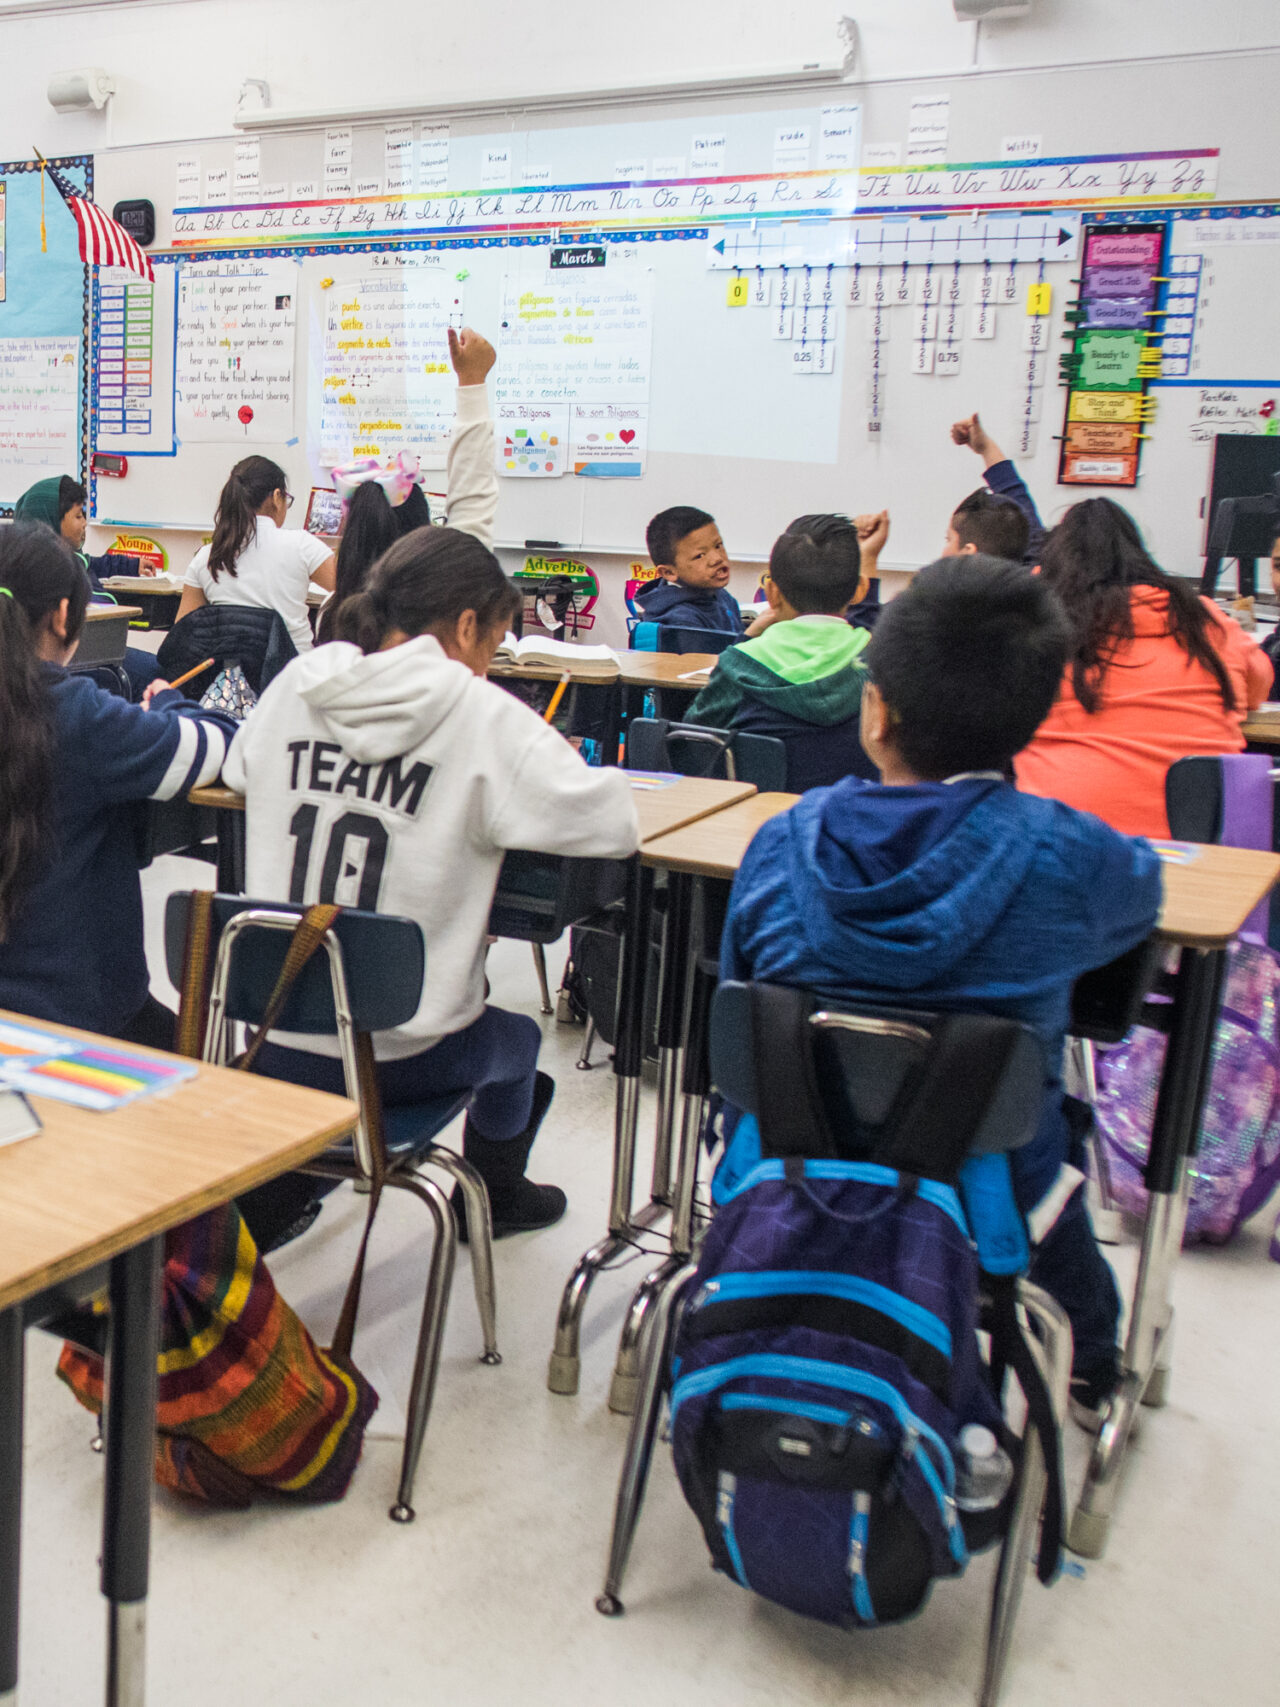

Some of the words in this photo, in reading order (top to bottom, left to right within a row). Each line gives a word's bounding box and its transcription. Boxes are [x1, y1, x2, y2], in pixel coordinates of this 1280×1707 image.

[558, 249, 597, 267] March
[1096, 308, 1117, 318] Good
[1118, 308, 1138, 320] Day
[1091, 350, 1117, 362] Ready
[1119, 350, 1130, 360] to
[1096, 360, 1123, 371] Learn
[500, 405, 517, 419] Son
[575, 404, 588, 418] No
[591, 408, 605, 418] son
[116, 534, 154, 552] Nouns
[525, 556, 586, 574] Adverbs
[287, 739, 435, 817] TEAM
[289, 803, 389, 913] 10
